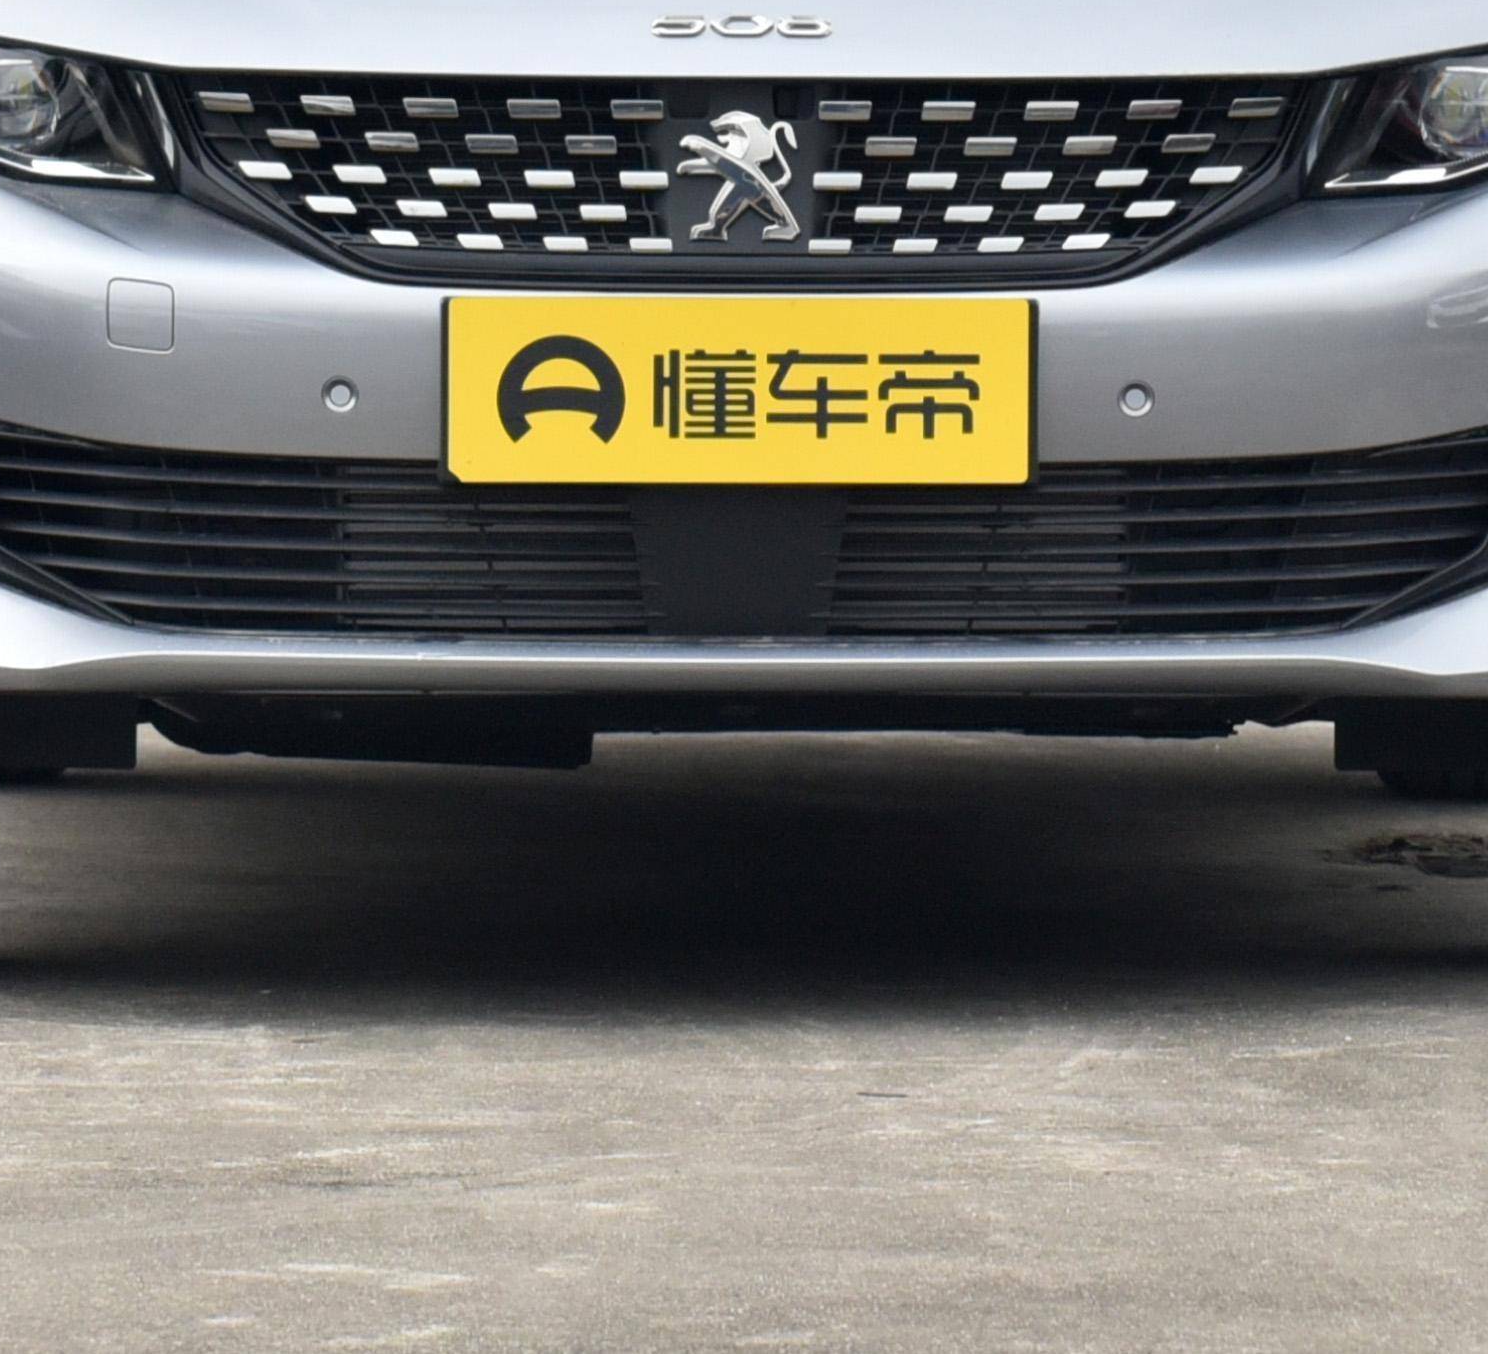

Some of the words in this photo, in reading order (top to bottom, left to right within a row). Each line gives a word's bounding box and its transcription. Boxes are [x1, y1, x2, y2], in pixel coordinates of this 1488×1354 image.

[651, 14, 834, 39] 508
[652, 349, 981, 440] 懂车帝
